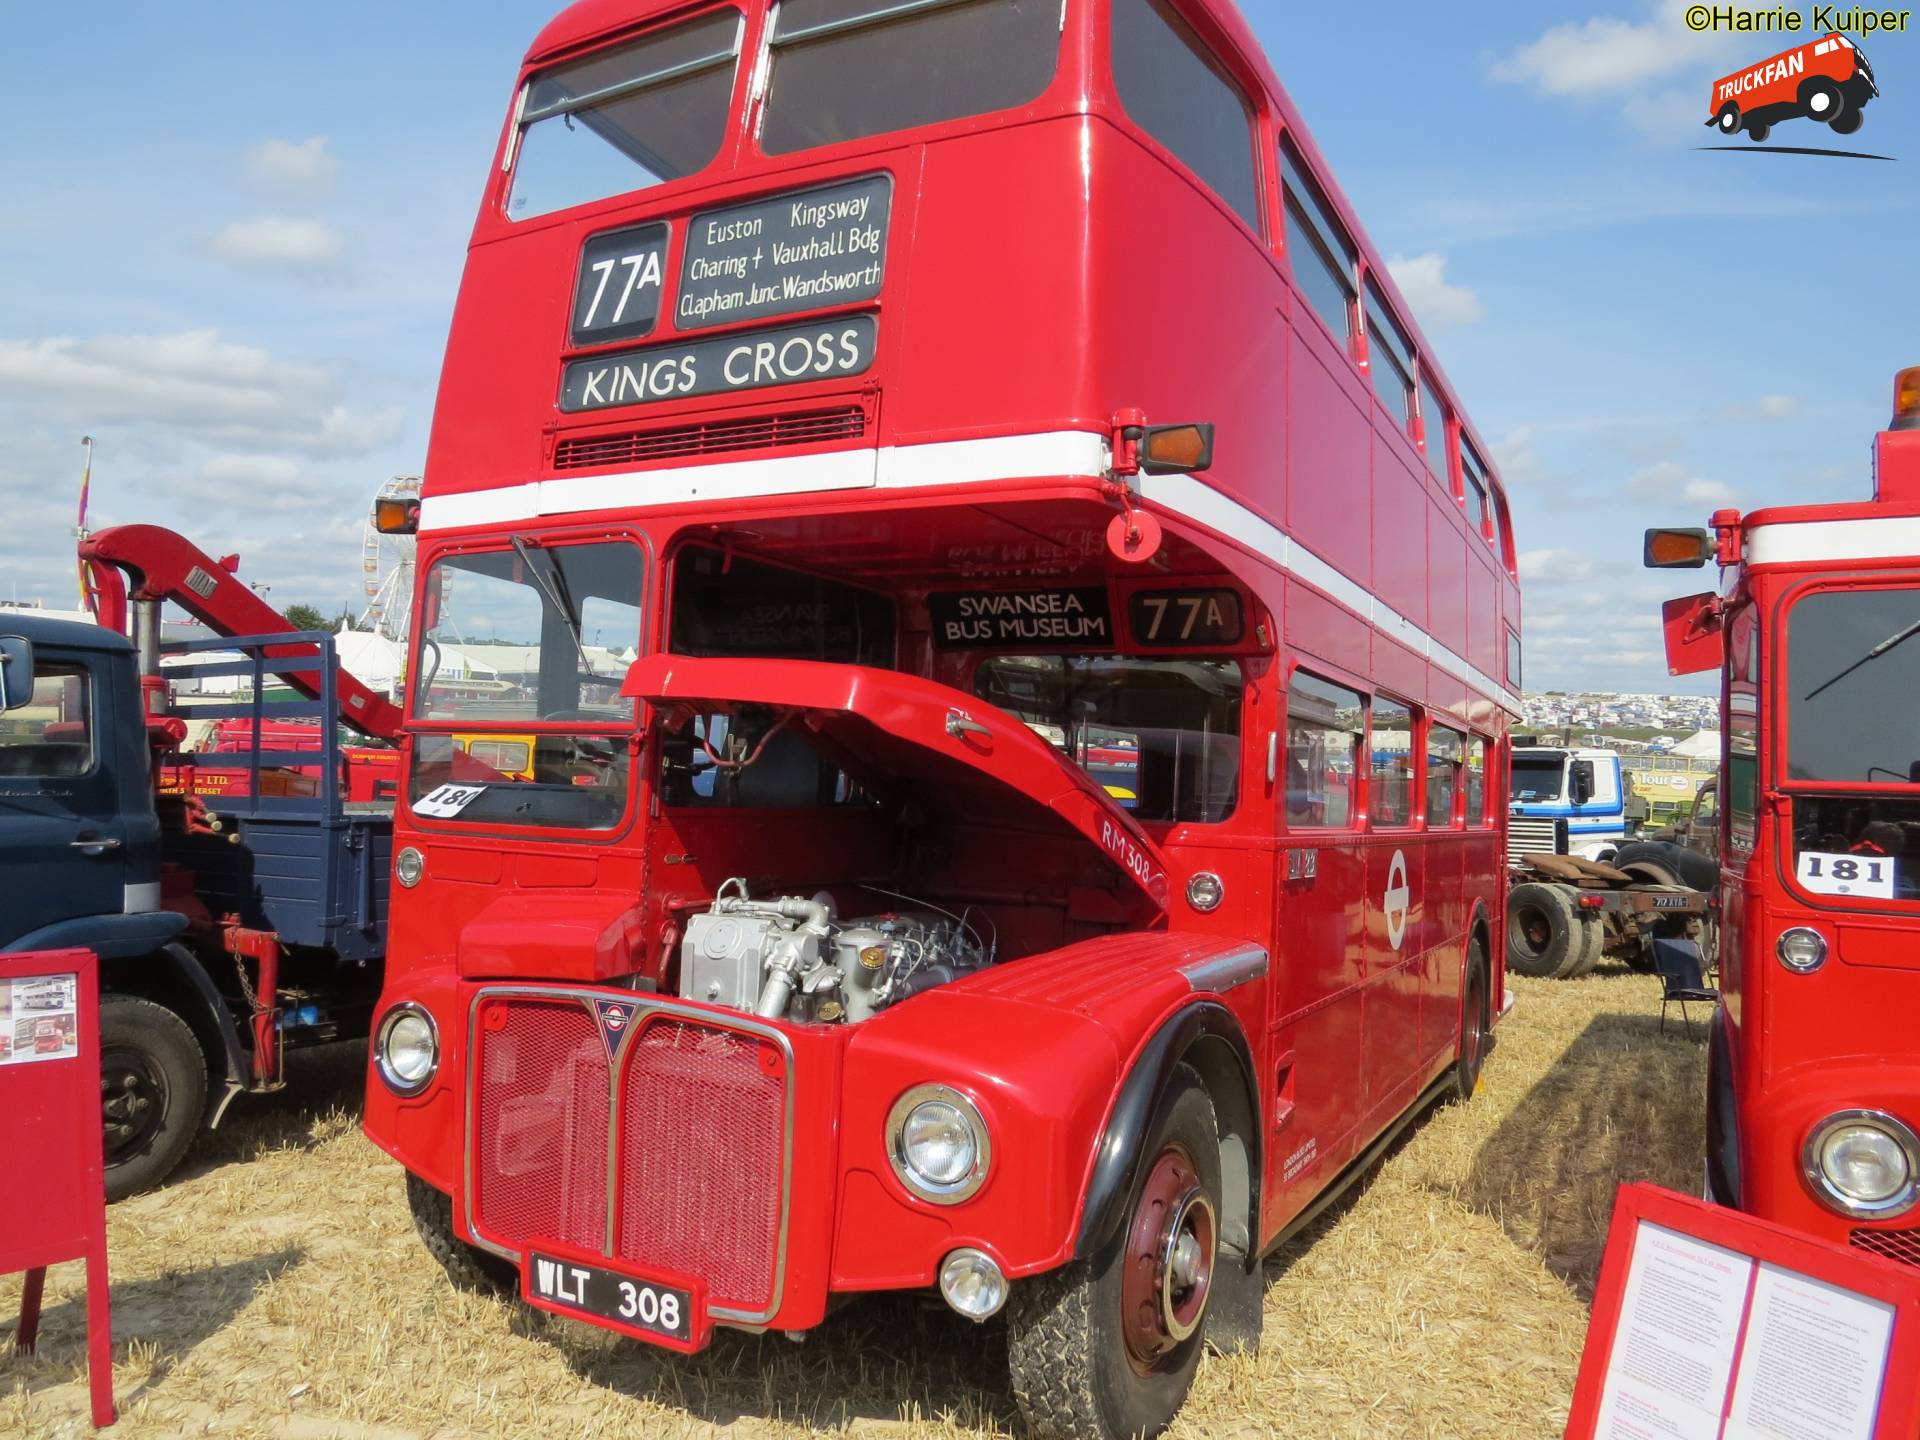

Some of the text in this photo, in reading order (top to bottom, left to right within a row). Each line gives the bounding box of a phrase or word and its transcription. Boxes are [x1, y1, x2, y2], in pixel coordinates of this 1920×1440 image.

[708, 196, 870, 245] Euston Kingsway
[691, 254, 748, 281] Charing
[772, 236, 844, 266] Vauxhall
[848, 228, 881, 254] Bdg
[583, 252, 662, 328] 77A
[680, 291, 752, 319] Clapham
[782, 260, 881, 300] Wandsworth
[582, 330, 859, 406] KINGS CROSS
[945, 617, 1105, 640] BUS MUSEUM
[959, 593, 1084, 616] SWANSEA
[1143, 598, 1224, 640] 77A
[1807, 857, 1883, 883] 181
[537, 1259, 680, 1330] WLT 308
